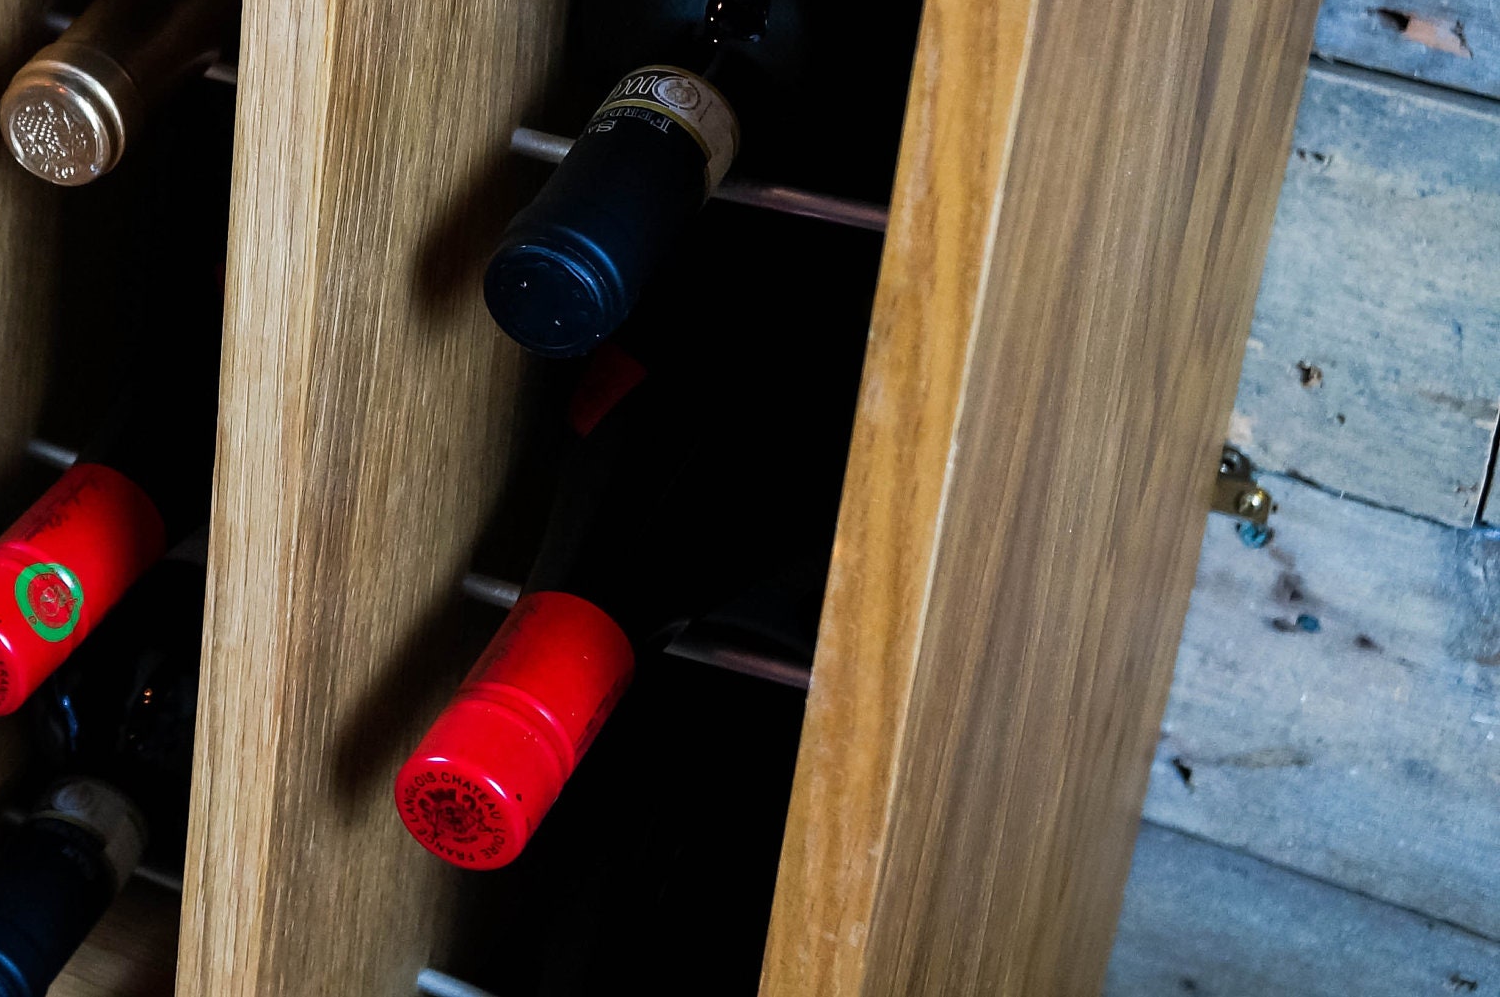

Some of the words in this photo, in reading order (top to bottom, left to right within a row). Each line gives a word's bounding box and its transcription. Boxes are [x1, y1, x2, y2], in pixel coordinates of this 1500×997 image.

[404, 771, 437, 823] LANGLOIS
[440, 771, 504, 820] CHATEAU
[417, 828, 476, 863] FRANCE
[480, 827, 506, 860] LOIRE
